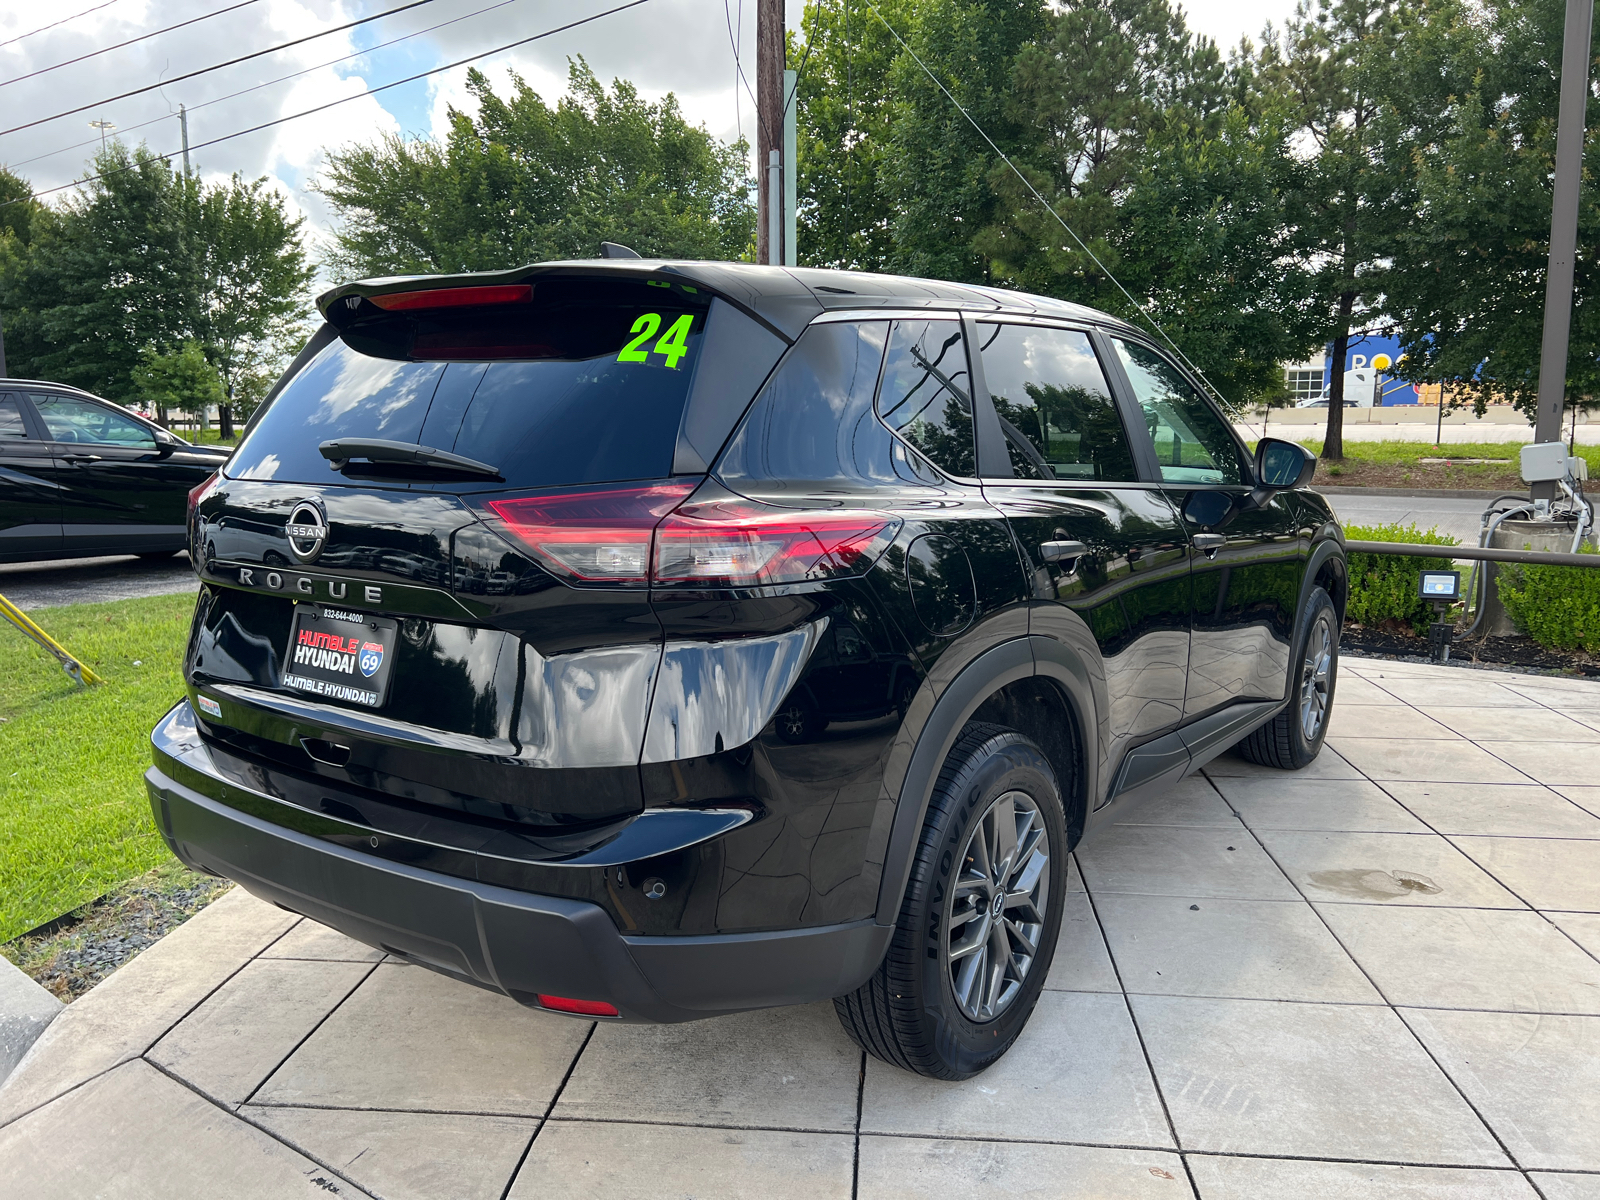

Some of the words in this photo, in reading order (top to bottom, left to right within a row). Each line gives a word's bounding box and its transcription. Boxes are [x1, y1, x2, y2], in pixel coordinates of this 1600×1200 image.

[616, 312, 695, 369] 24
[286, 524, 325, 538] NISSAN
[239, 568, 382, 604] ROGUE
[323, 608, 364, 623] 832-644-4000
[298, 629, 360, 654] HUMBLE
[294, 645, 356, 674] HYUNDAI
[361, 654, 379, 671] 69
[283, 674, 325, 694] HUMBLE
[324, 683, 370, 705] HYUNDAI
[927, 784, 982, 960] INVOVIC
